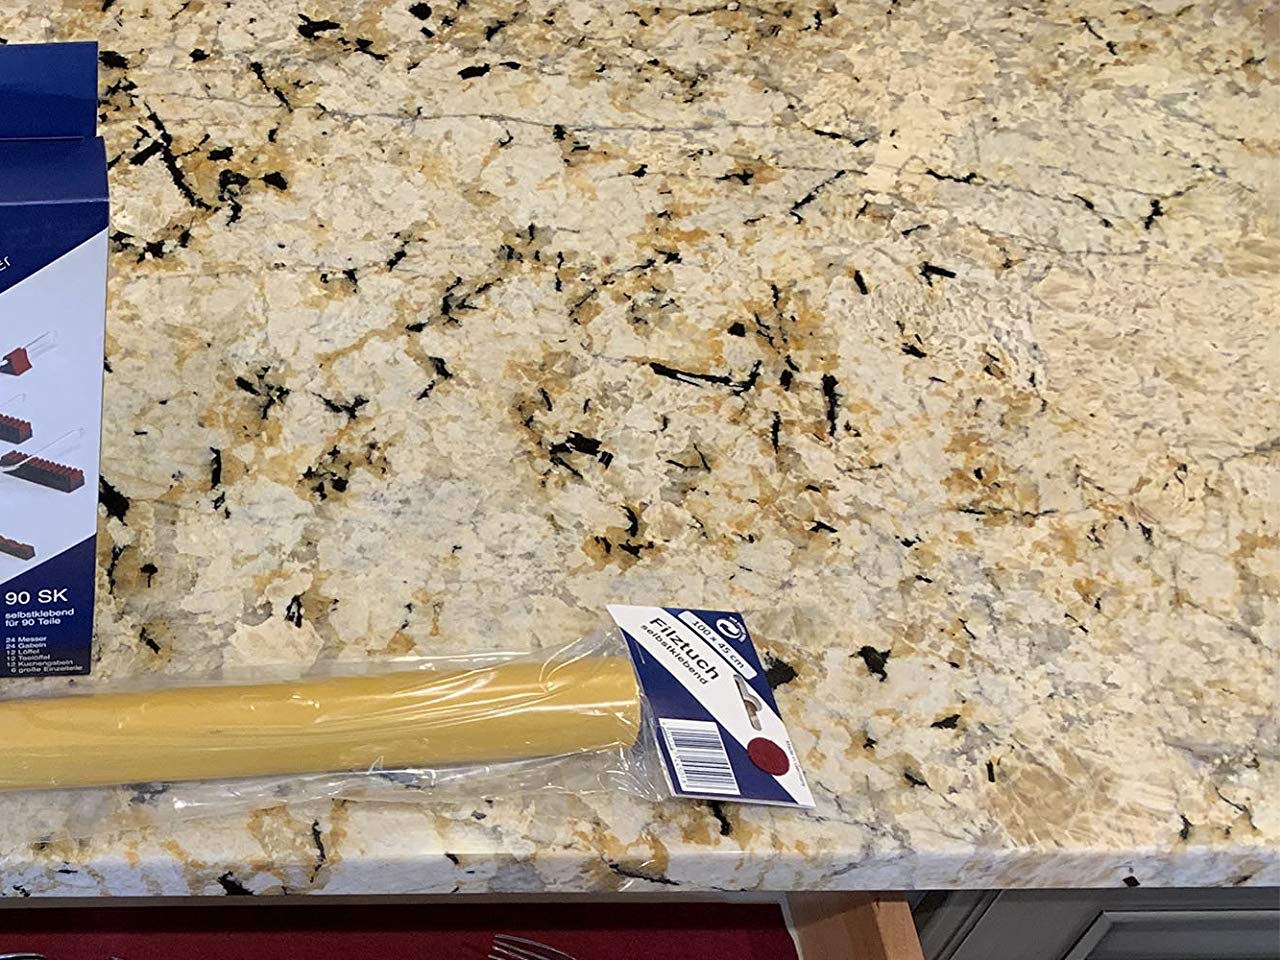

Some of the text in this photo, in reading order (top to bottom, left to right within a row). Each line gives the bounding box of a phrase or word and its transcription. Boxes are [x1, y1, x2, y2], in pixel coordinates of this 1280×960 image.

[5, 588, 68, 605] 90 SK
[5, 608, 75, 619] selbstklebend
[5, 617, 61, 627] für 90 Teile
[640, 624, 709, 685] selbstklebend
[649, 617, 720, 680] Filztuch
[692, 620, 711, 636] 100
[718, 642, 732, 656] 45
[729, 654, 745, 669] cm
